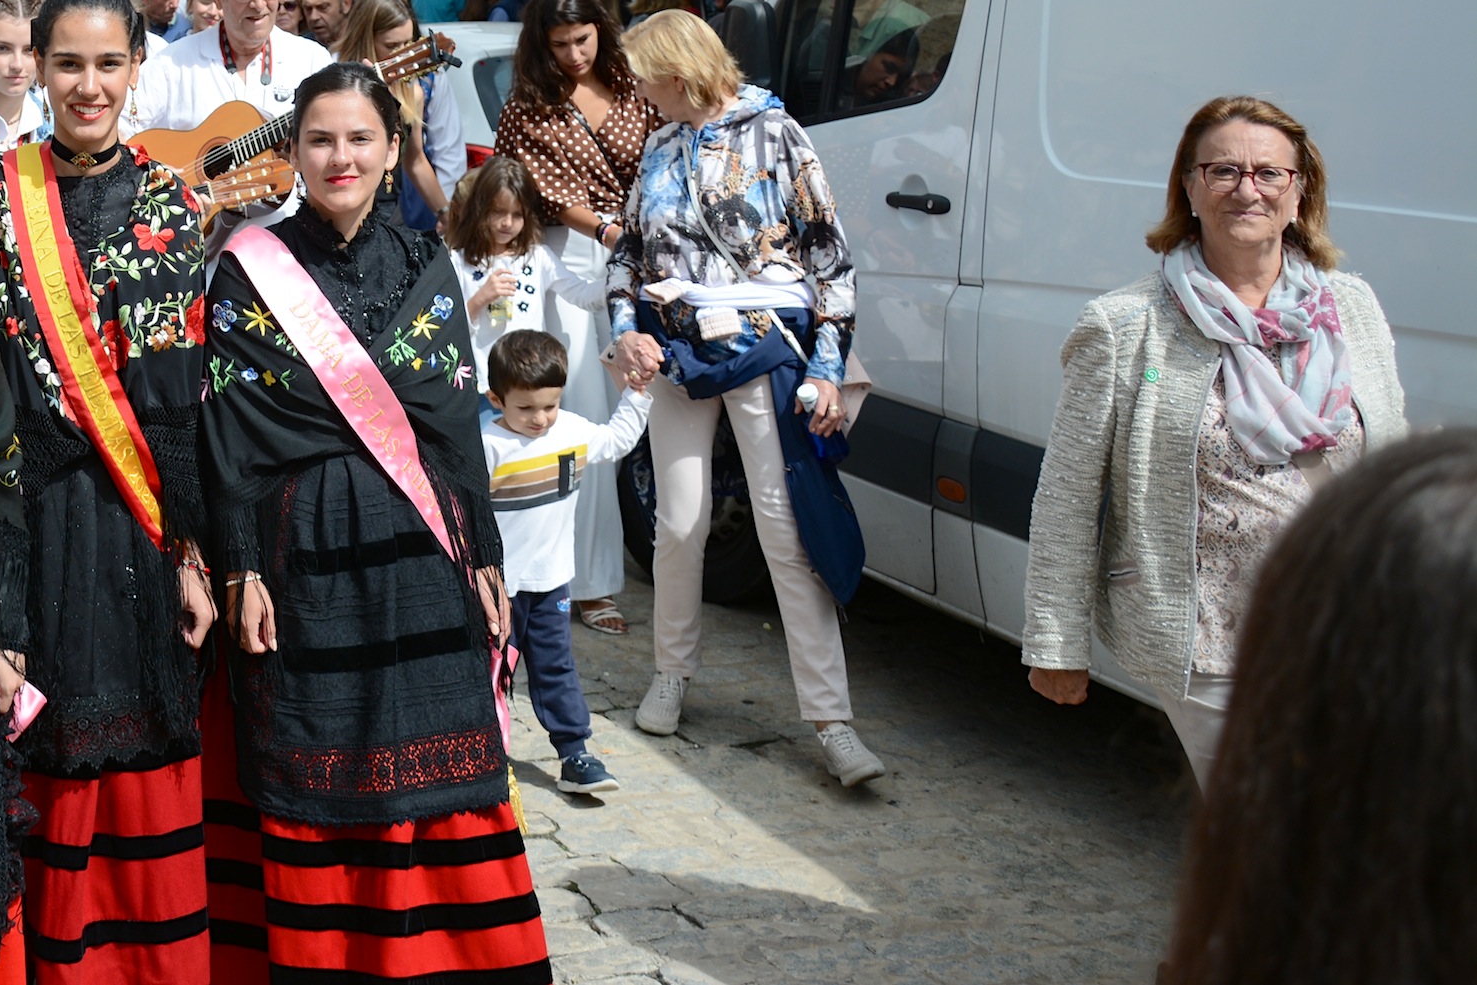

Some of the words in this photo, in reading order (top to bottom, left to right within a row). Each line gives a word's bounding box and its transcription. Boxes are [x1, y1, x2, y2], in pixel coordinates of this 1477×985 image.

[44, 268, 69, 305] DE
[56, 311, 88, 359] LAS
[78, 367, 134, 463] FIESTAS
[289, 299, 346, 371] DAMA
[341, 371, 374, 408] DE
[365, 409, 402, 457] LAS
[401, 459, 440, 516] FIES
